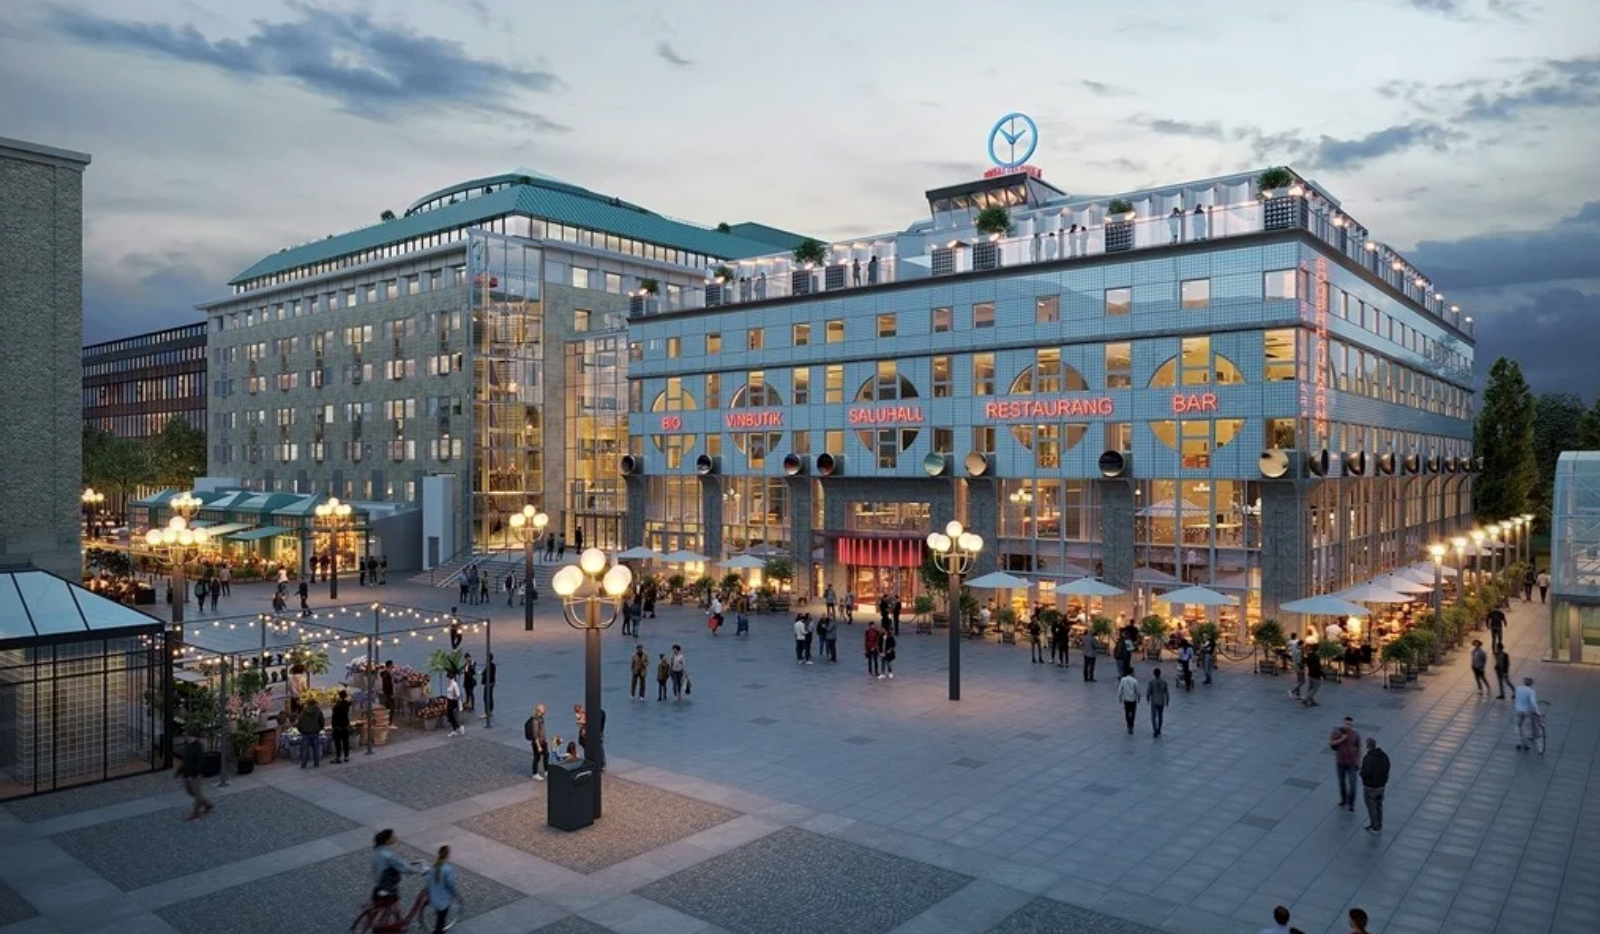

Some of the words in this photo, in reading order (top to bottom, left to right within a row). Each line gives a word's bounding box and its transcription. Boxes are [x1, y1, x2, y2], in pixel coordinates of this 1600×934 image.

[985, 398, 1113, 418] RESTAURANG
[1172, 394, 1217, 413] BAR
[661, 416, 681, 430] BIO
[726, 412, 782, 428] VINBUTIK
[848, 407, 924, 423] SALUHALL
